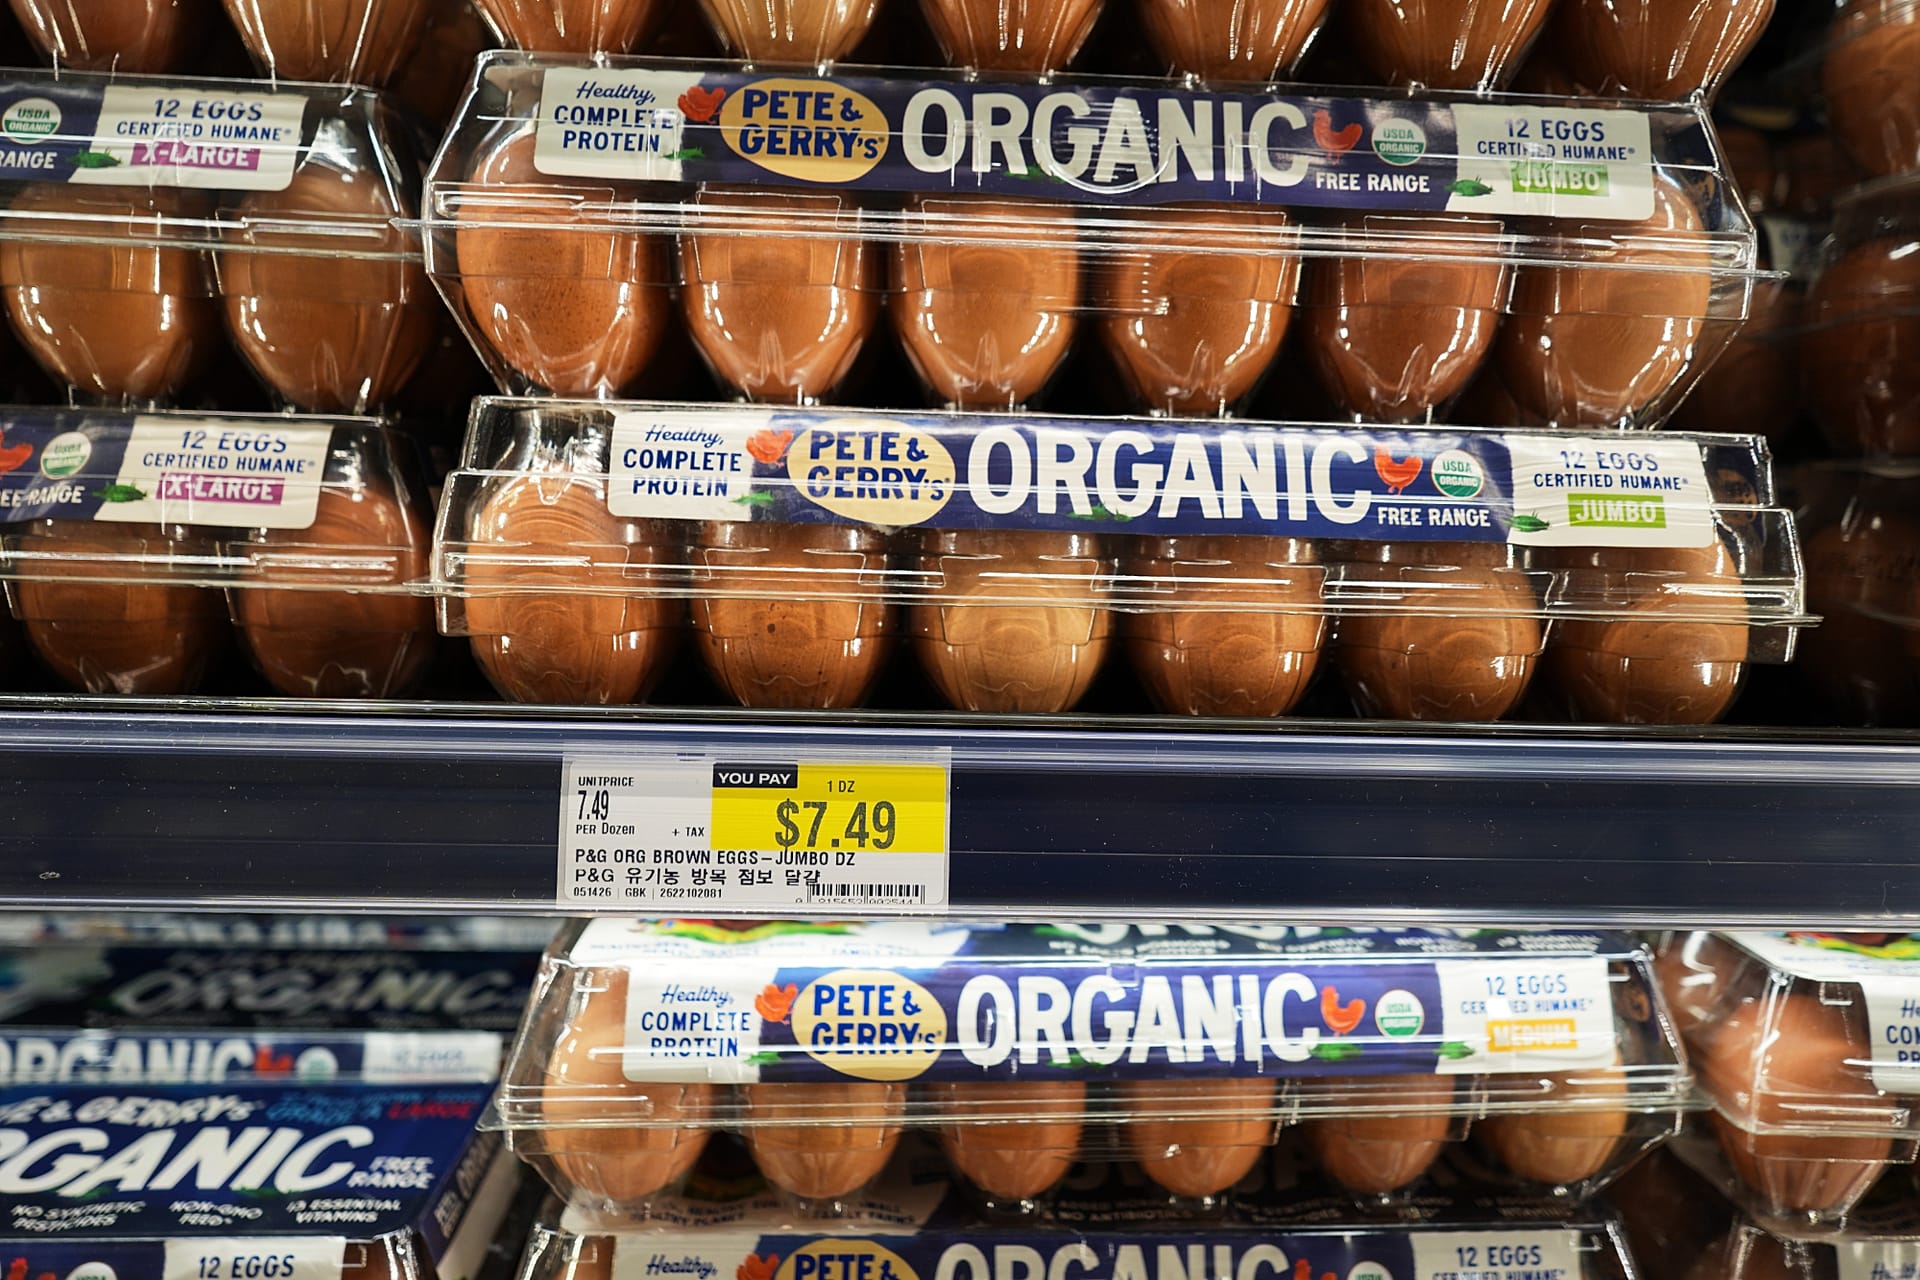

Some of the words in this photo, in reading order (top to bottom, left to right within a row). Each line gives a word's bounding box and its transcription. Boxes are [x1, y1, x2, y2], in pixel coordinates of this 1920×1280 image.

[576, 81, 656, 105] Healthy,
[17, 108, 50, 119] USDA
[154, 99, 180, 117] 12
[191, 100, 263, 121] EGGS
[742, 88, 834, 121] PETE
[840, 97, 864, 121] &
[9, 121, 52, 133] ORGANIC
[554, 105, 674, 129] COMPLETE
[116, 120, 203, 137] CERTIFIED
[902, 88, 1308, 187] ORGANIC
[1382, 127, 1414, 141] USDA
[1505, 118, 1530, 138] 12
[1541, 120, 1605, 142] EGGS
[562, 130, 660, 153] PROTEIN
[1379, 141, 1420, 154] ORGANIC
[1477, 140, 1556, 158] CERTIFIED
[141, 142, 250, 167] X-LARGE
[1316, 172, 1361, 191] FREE
[1367, 173, 1430, 194] RANGE
[1519, 166, 1600, 192] JUMBO
[182, 430, 207, 449] 12
[218, 432, 288, 453] EGGS
[645, 424, 724, 448] Healthy,
[809, 429, 900, 461] PETE
[906, 437, 929, 461] &
[143, 452, 228, 470] CERTIFIED
[623, 449, 742, 472] COMPLETE
[1442, 460, 1472, 474] USDA
[1560, 450, 1586, 469] 12
[1600, 451, 1659, 472] EGGS
[632, 476, 728, 498] PROTEIN
[967, 428, 1372, 524] ORGANIC
[1438, 475, 1479, 488] ORGANIC
[1534, 472, 1614, 489] CERTIFIED
[27, 485, 86, 506] RANGE
[166, 474, 274, 501] X-LARGE
[1377, 506, 1423, 527] FREE
[1428, 508, 1491, 528] RANGE
[1575, 500, 1658, 524] JUMBO
[578, 776, 635, 788] UNITPRICE
[718, 773, 755, 785] YOU
[758, 773, 791, 786] PAY
[826, 780, 833, 793] 1
[838, 780, 856, 794] DZ
[577, 790, 610, 821] 7.49
[575, 824, 597, 835] PER
[601, 823, 635, 836] Dozen
[685, 826, 705, 838] TAX
[775, 798, 897, 851] $7.49
[575, 849, 608, 864] P&G
[613, 849, 646, 864] ORG
[652, 850, 711, 865] BROWN
[834, 851, 856, 866] DZ
[575, 869, 615, 883] P&G
[625, 867, 680, 885] 유기농
[690, 868, 727, 886] 방목
[738, 868, 774, 886] 점보
[784, 869, 821, 887] 달걀
[573, 886, 612, 898] 051426
[624, 888, 647, 898] GBK
[659, 887, 723, 899] 2622102081
[661, 984, 735, 1009] Healthy,
[1486, 976, 1506, 997] 12
[1516, 974, 1568, 994] EGGS
[813, 984, 895, 1016] PETE
[902, 989, 921, 1015] &
[641, 1011, 751, 1032] COMPLETE
[956, 972, 1321, 1067] ORGANIC
[650, 1037, 738, 1058] PROTEIN
[0, 1036, 254, 1083] RGANIC
[369, 1156, 434, 1172] FREE
[347, 1171, 436, 1189] RANGE
[11, 1204, 43, 1218] NO
[44, 1200, 146, 1220] SYNTHETIC
[169, 1200, 264, 1220] NON-GMO
[308, 1198, 402, 1212] ESSENTIAL
[295, 1210, 379, 1224] VITAMINS
[200, 1256, 221, 1279] 12
[231, 1254, 295, 1279] EGGS
[794, 1253, 875, 1280] PETE
[1456, 1246, 1478, 1268] 12
[1487, 1245, 1542, 1267] EGGS
